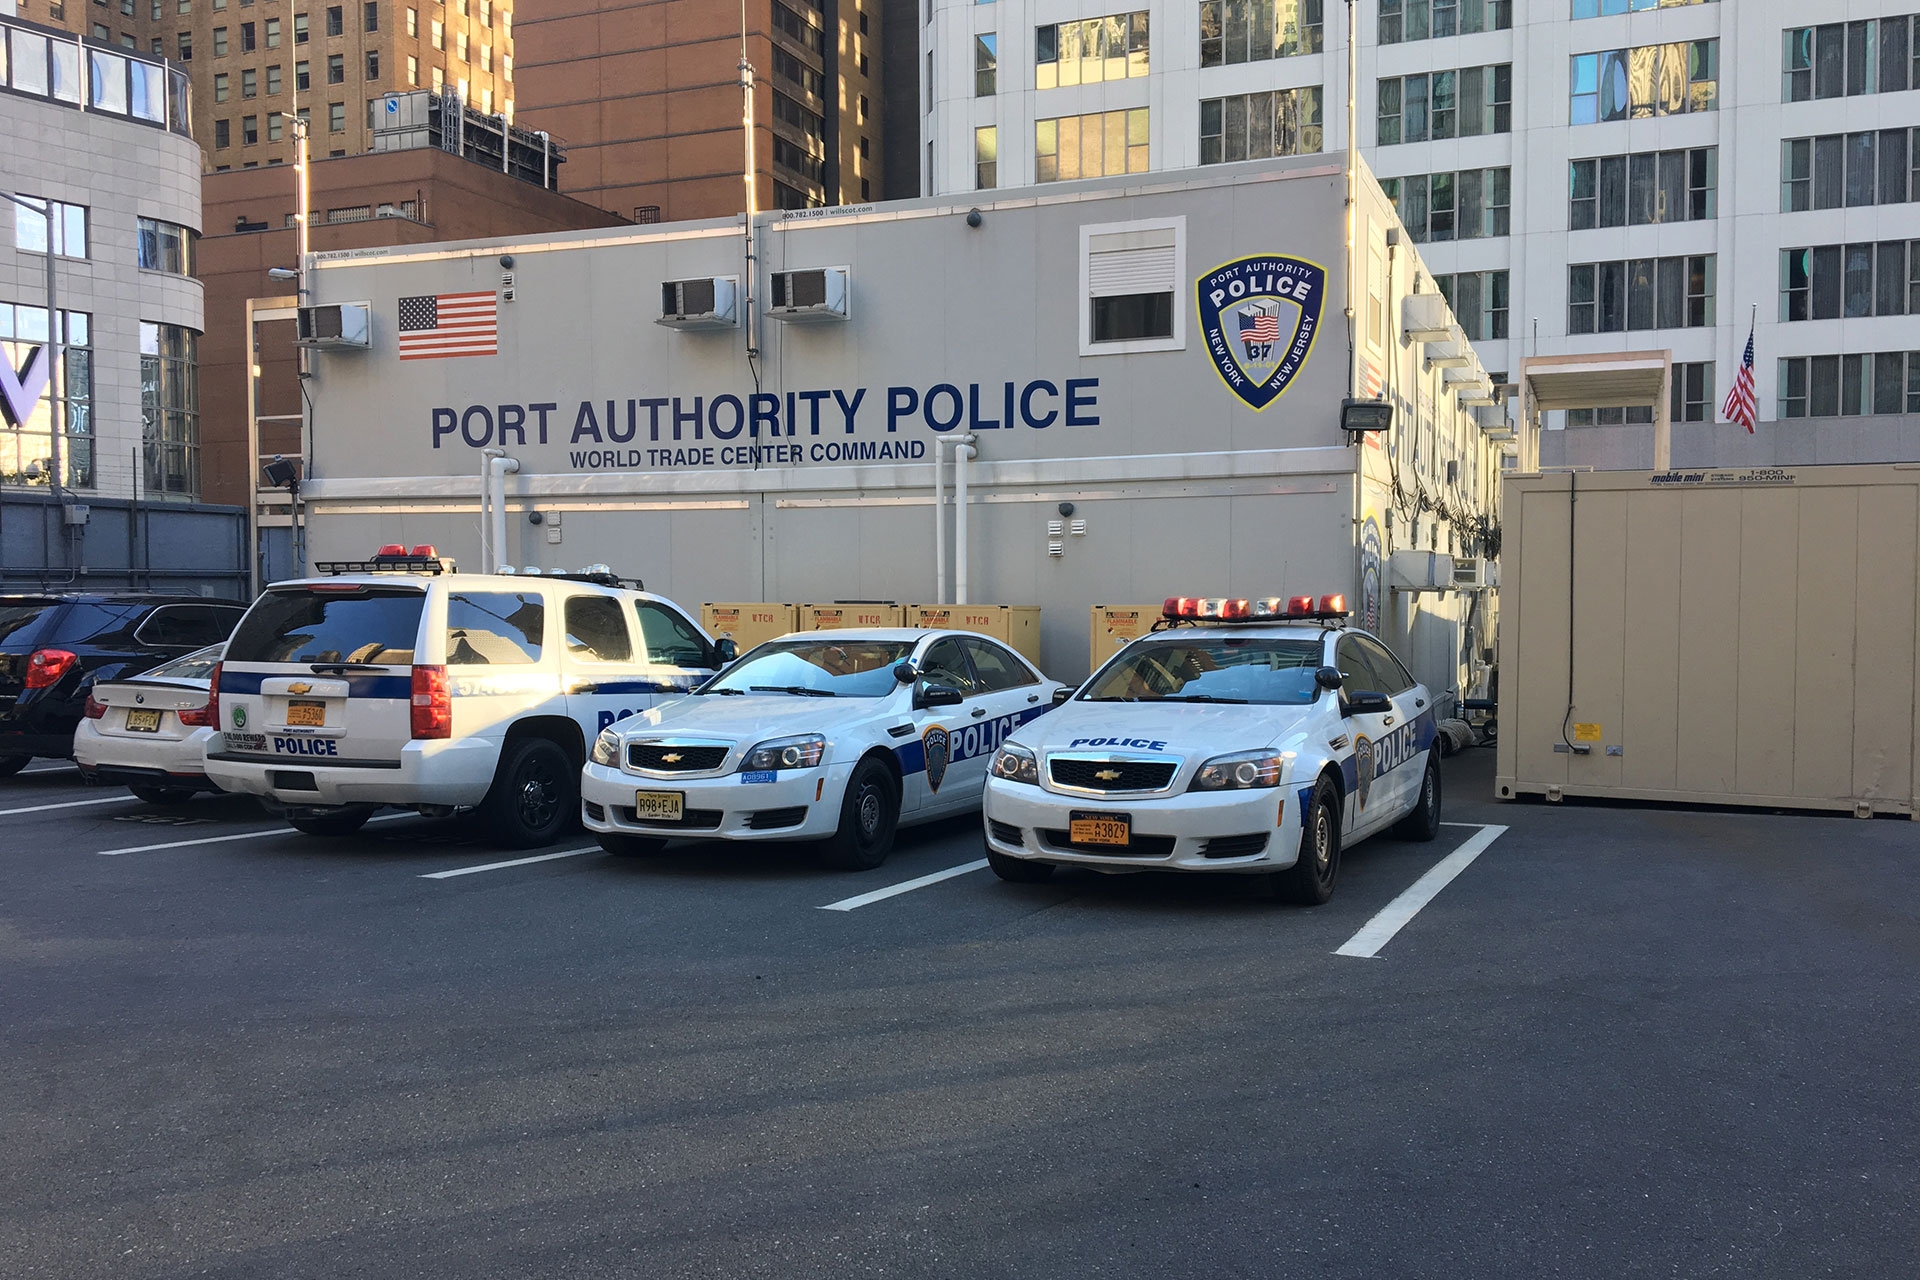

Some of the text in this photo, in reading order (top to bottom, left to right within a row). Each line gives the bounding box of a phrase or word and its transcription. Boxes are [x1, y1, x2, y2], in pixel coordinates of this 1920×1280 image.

[829, 206, 873, 215] willscot.com
[1210, 262, 1313, 287] PORT AUTHORITY
[1209, 274, 1312, 308] POLICE
[1209, 328, 1245, 387] NEW YORK
[1270, 314, 1314, 390] NEW JERSEY
[431, 377, 1100, 449] PORT AUTHORITY POLICE
[569, 439, 925, 469] WORLD TRADE CENTER COMMAND
[1651, 471, 1706, 483] mobile mini
[273, 737, 338, 756] POLICE
[926, 734, 946, 750] POLICE
[949, 713, 1021, 762] POLICE
[1069, 737, 1168, 752] POLICE
[1373, 720, 1417, 778] POLICE
